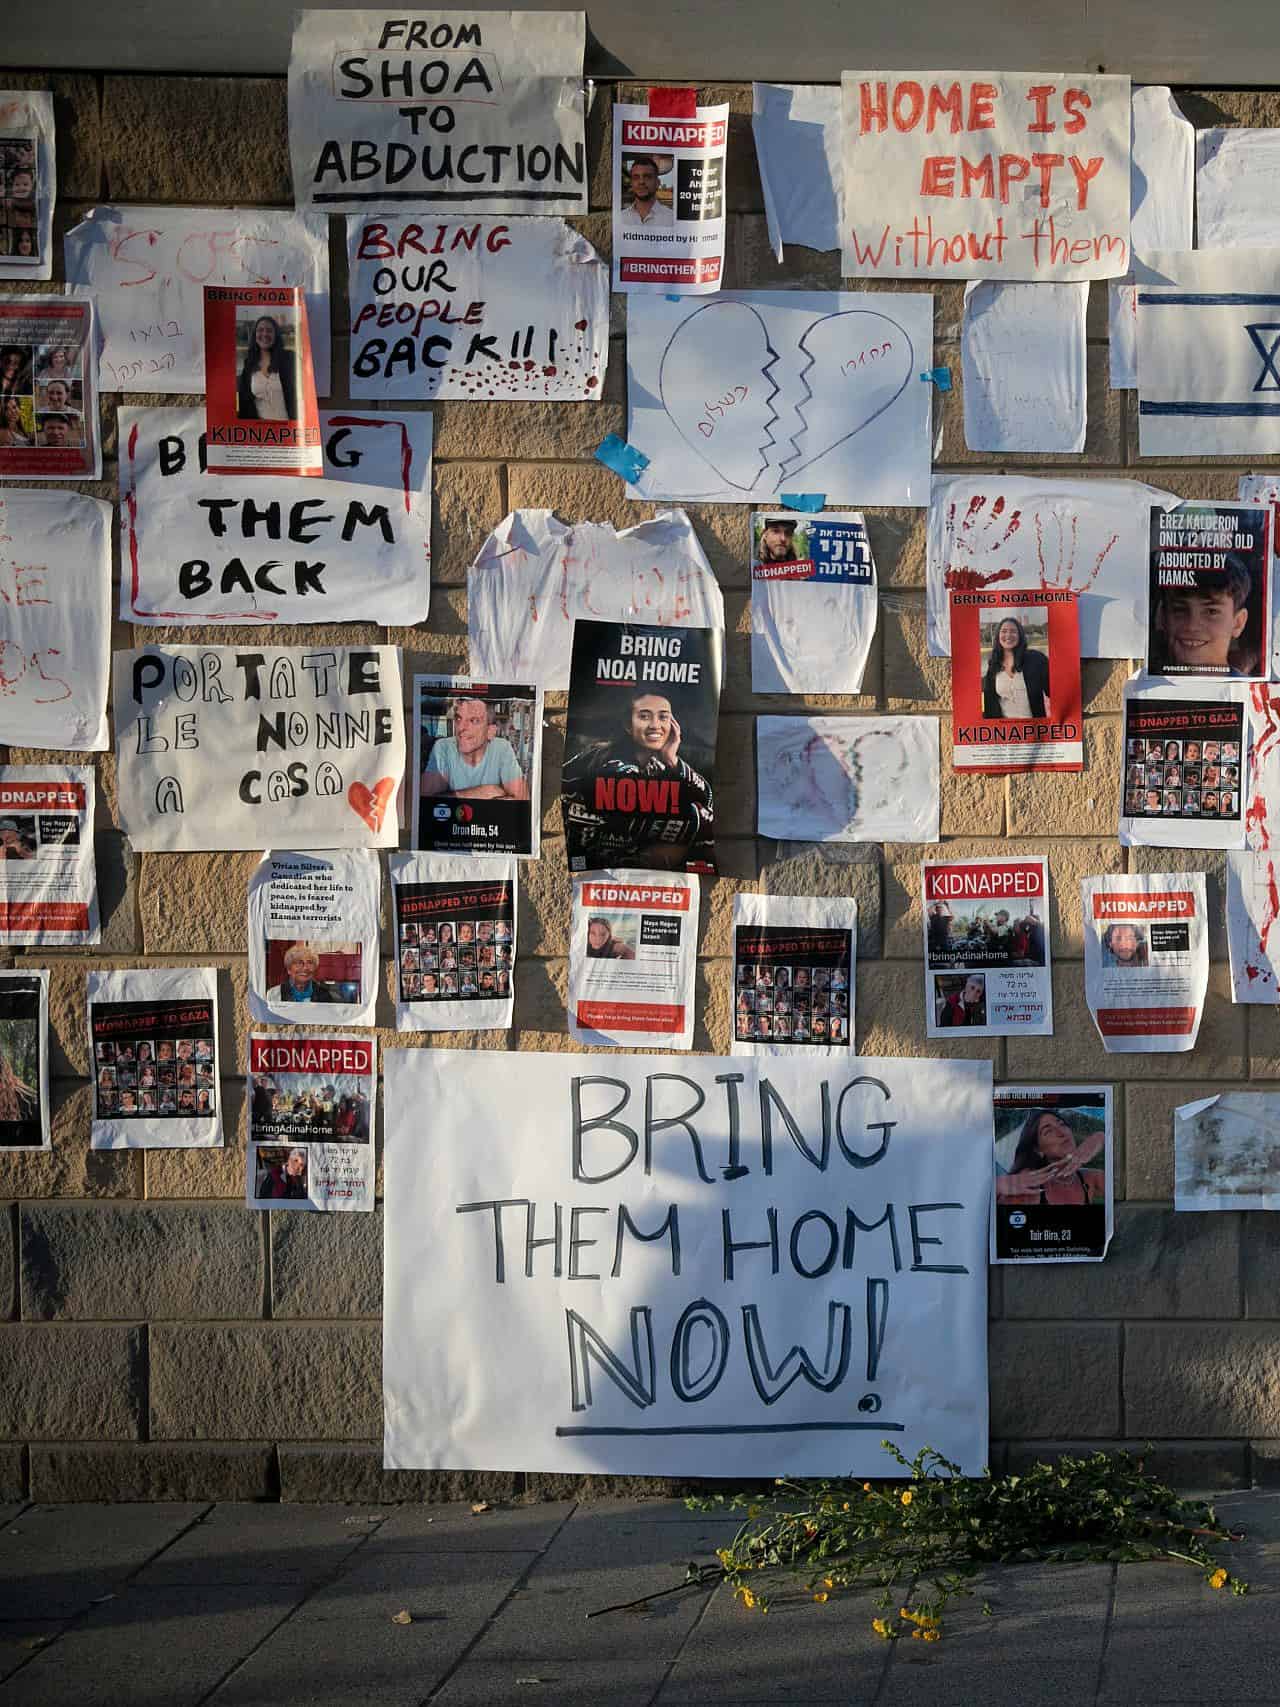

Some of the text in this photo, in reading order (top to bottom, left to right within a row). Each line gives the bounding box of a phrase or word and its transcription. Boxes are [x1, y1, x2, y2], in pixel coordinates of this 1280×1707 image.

[377, 19, 483, 51] FROM
[338, 56, 495, 100] SHOA
[401, 106, 457, 136] TO
[859, 80, 1093, 137] HOME IS
[313, 141, 585, 184] ABDUCTION
[920, 152, 1104, 211] EMPTY
[357, 224, 512, 260] BRING
[623, 233, 688, 245] Kidnapped by
[852, 215, 1126, 270] Without them
[373, 260, 457, 294] OUR
[207, 290, 286, 302] BRING NOA
[352, 300, 486, 335] PEOPLE
[197, 498, 396, 545] THEM
[1160, 514, 1239, 531] EREZ KALDERON
[820, 539, 871, 563] רוני
[1160, 532, 1255, 549] ONLY 12 YEARS OLD
[819, 562, 871, 577] הביתה
[1159, 552, 1227, 569] ABDUCTED BY
[178, 557, 327, 600] BACK
[1159, 570, 1198, 587] HAMAS.
[953, 591, 1074, 605] BRING NOA HOME
[620, 634, 682, 658] BRING
[132, 650, 382, 704] PORTATE
[596, 658, 702, 684] NOA HOME
[136, 709, 393, 754] LE NONNE
[1208, 713, 1238, 724] GAZA
[958, 724, 1077, 742] KIDNAPPED
[0, 791, 77, 803] DNAPPED
[156, 761, 344, 814] A CASA
[595, 776, 680, 814] NOW!
[270, 882, 312, 891] dedicated
[589, 887, 685, 905] KIDNAPPED
[931, 871, 1041, 896] KIDNAPPED
[270, 902, 315, 913] kidnapped
[1101, 900, 1188, 913] KIDNAPPED
[257, 1047, 369, 1070] KIDNAPPED
[571, 1072, 898, 1184] BRING
[456, 1199, 969, 1283] THEM HOME
[567, 1276, 888, 1413] NOW!
